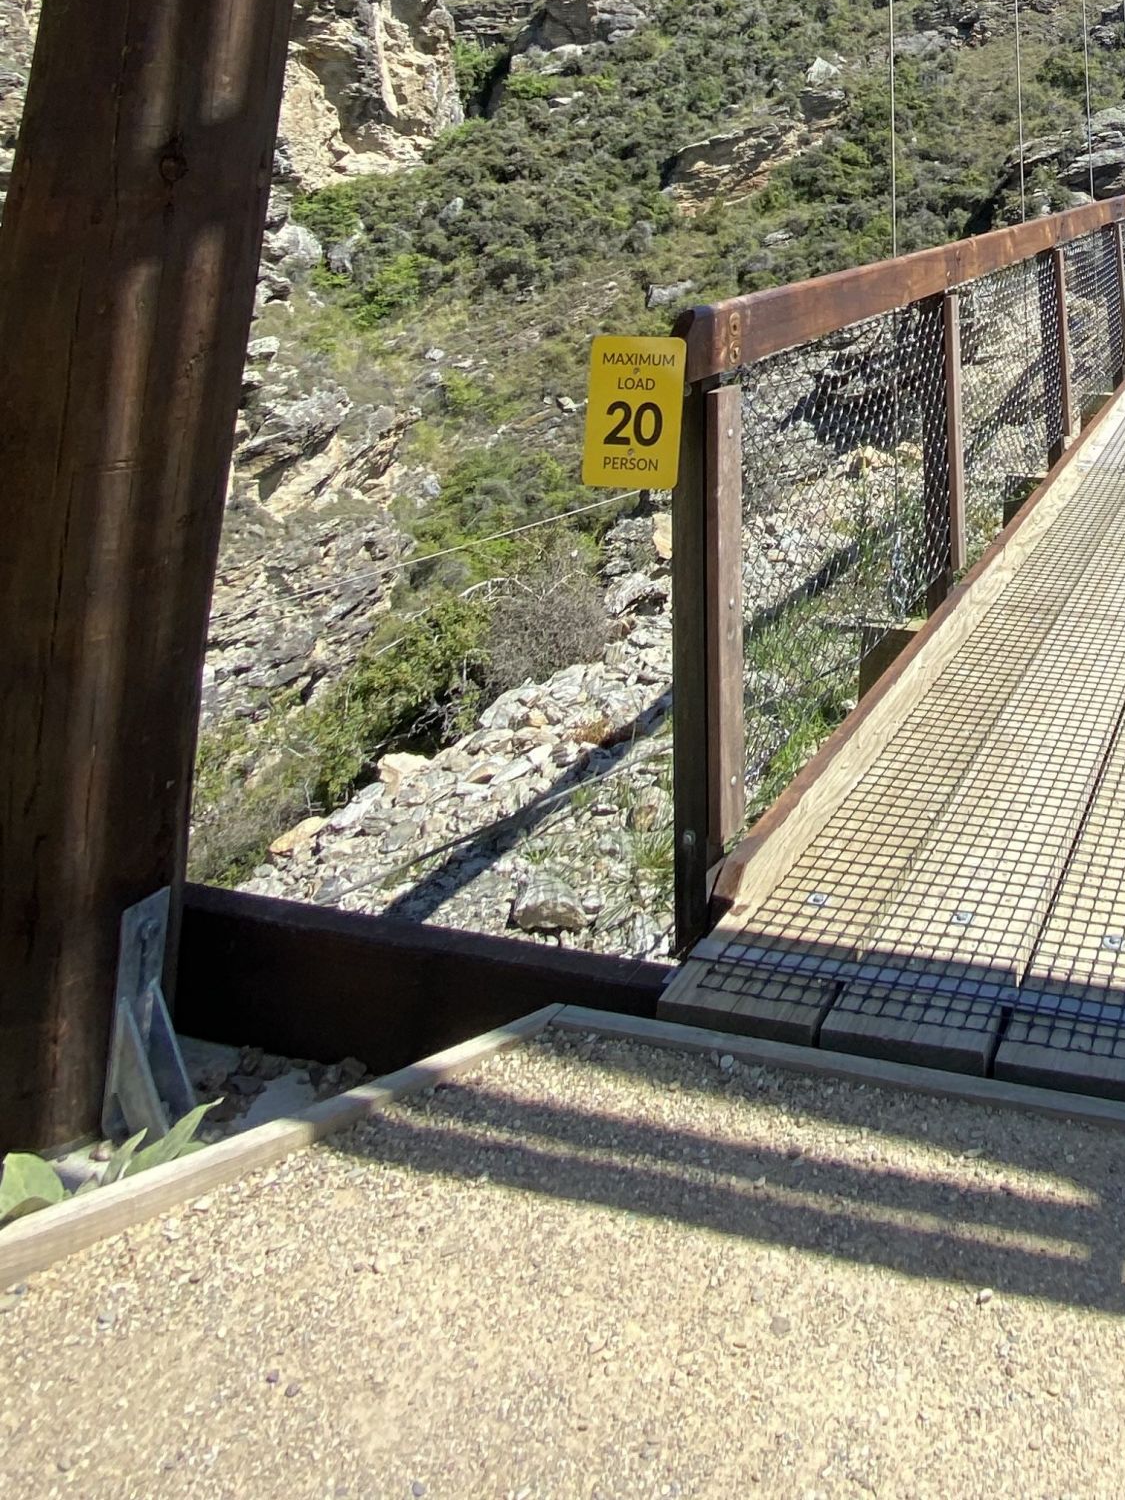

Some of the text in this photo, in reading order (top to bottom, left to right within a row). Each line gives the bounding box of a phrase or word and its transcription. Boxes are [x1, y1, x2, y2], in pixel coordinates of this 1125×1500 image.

[602, 353, 675, 367] MAXIMUM
[617, 378, 656, 391] LOAD
[603, 401, 663, 447] 20
[603, 457, 659, 471] PERSON
